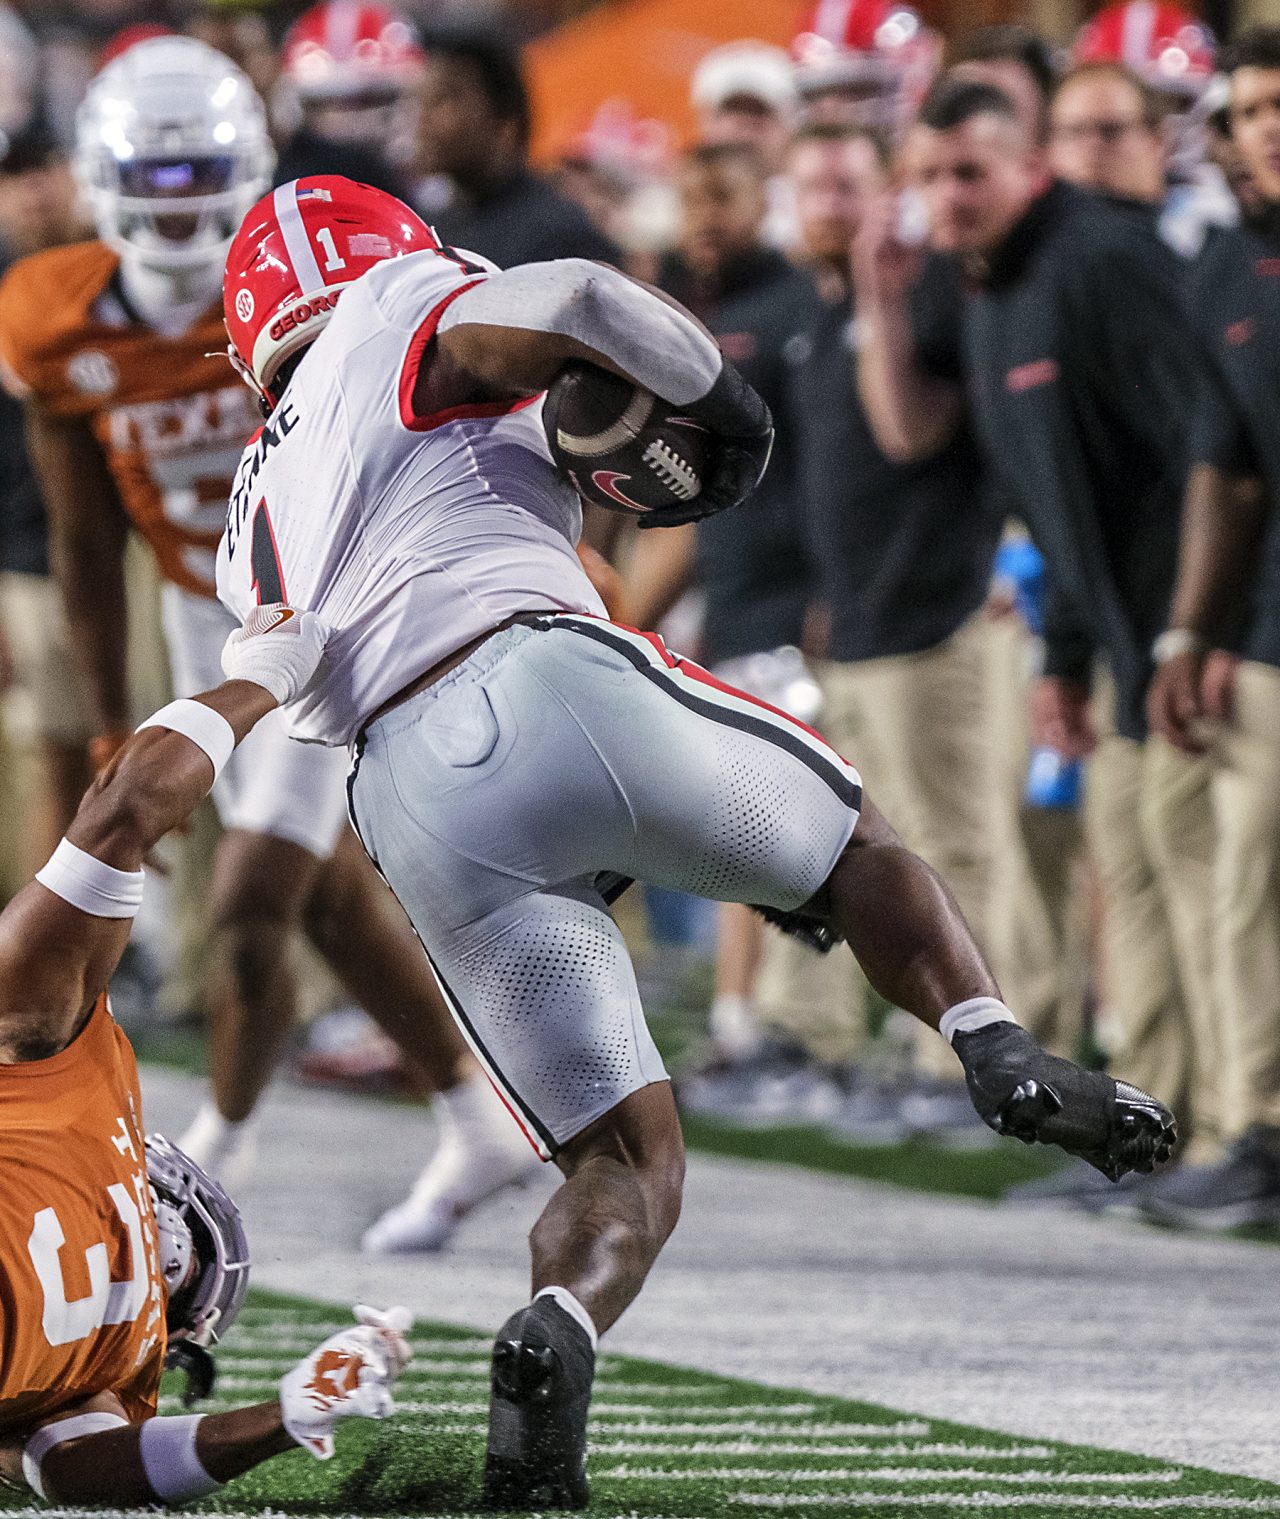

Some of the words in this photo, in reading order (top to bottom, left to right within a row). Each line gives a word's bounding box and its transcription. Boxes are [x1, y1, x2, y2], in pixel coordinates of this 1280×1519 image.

[316, 227, 346, 272] 1
[109, 389, 260, 452] TEXA
[250, 496, 288, 606] 1
[27, 1183, 150, 1346] 3
